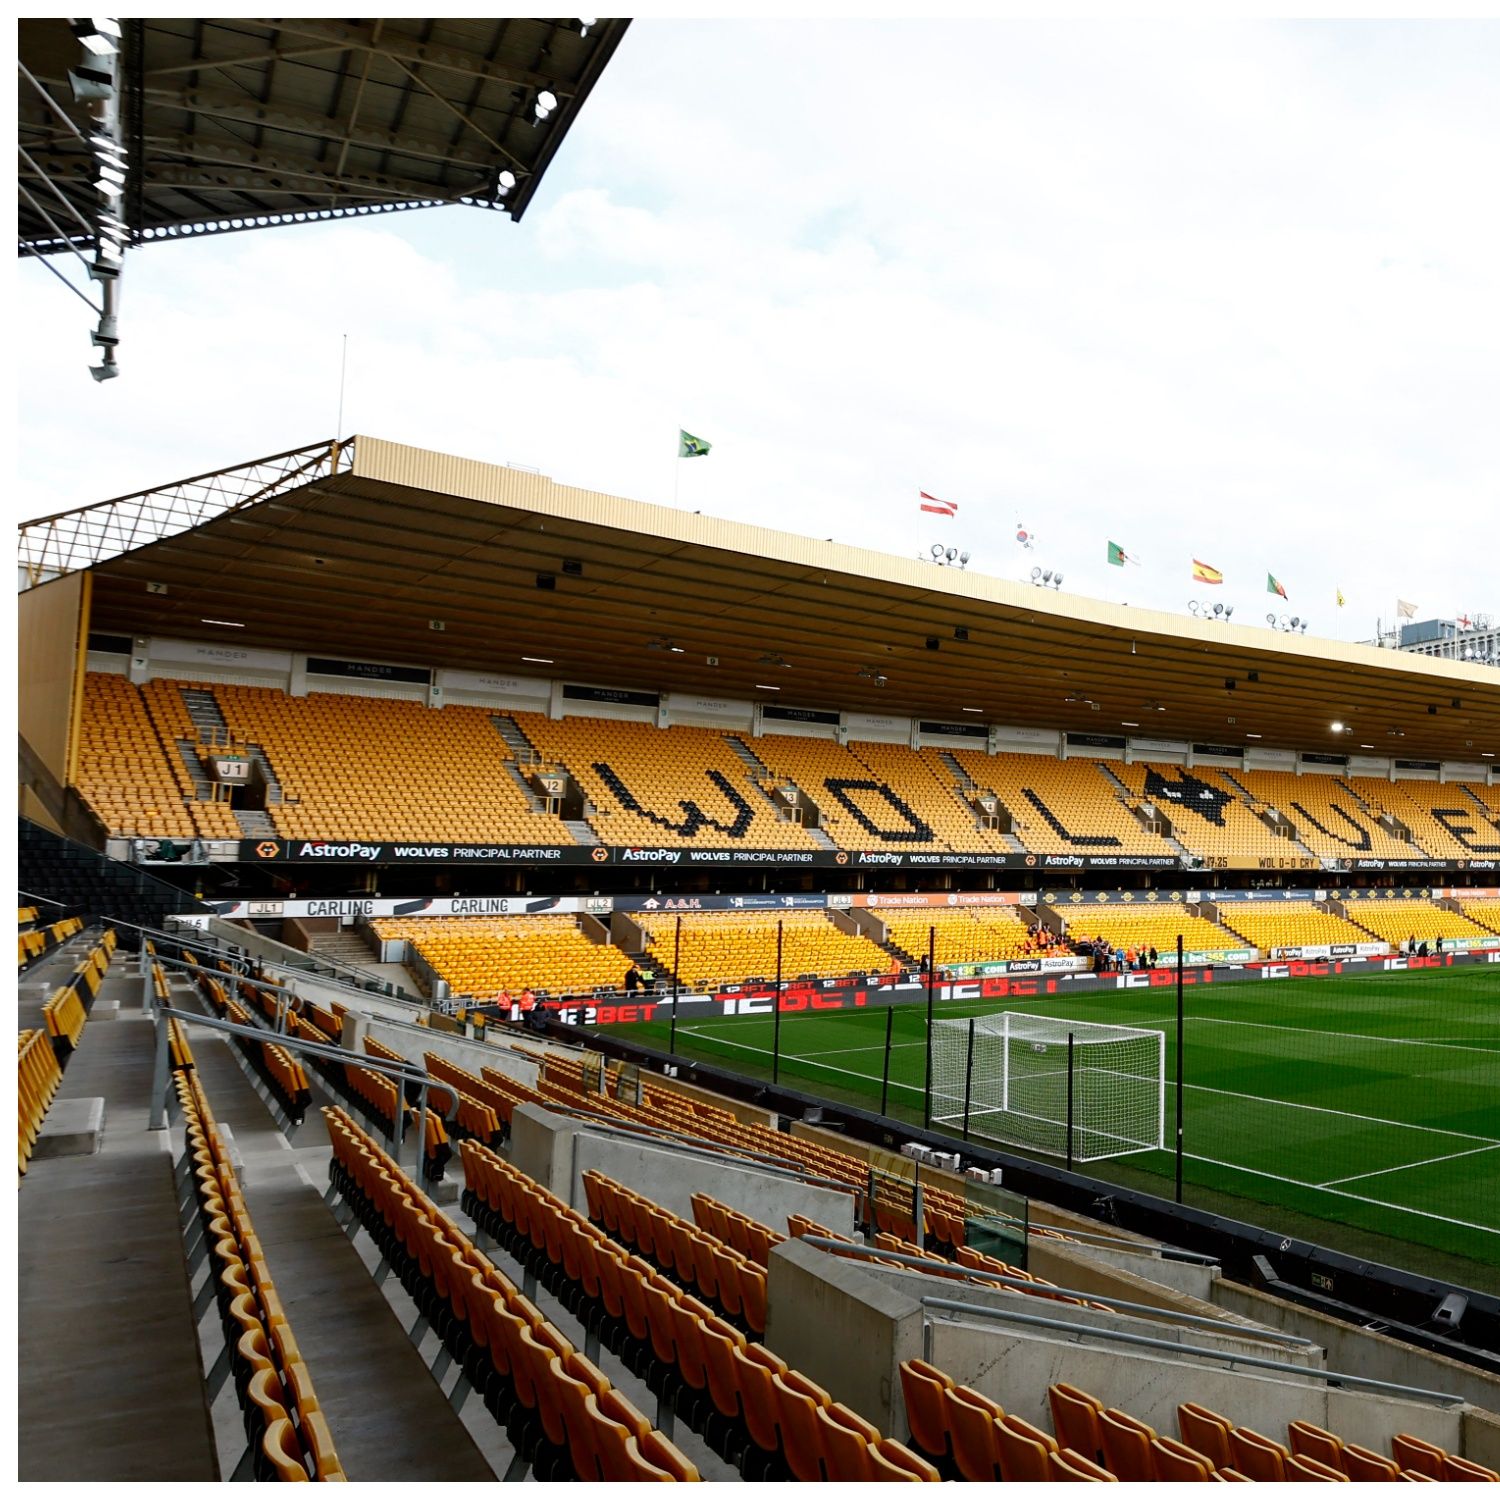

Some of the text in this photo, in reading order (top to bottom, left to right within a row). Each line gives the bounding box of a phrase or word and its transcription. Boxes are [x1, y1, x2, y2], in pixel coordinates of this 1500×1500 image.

[197, 649, 248, 660] MANDER
[347, 664, 393, 674] MANDER
[479, 678, 519, 687] MANDER
[594, 690, 629, 699] MANDER
[786, 710, 816, 718] MANDER
[300, 842, 561, 860] AstroPay WOLVES PRINCIPAL PARTNER
[623, 848, 813, 864] AstroPay WOLVES PRINCIPAL PARTNER
[858, 852, 1006, 865] AstroPay WOLVES PRINCIPAL PARTNER
[1045, 855, 1084, 867] AstroPay
[1090, 857, 1117, 865] WOLVES
[1258, 857, 1275, 868] WOL
[1300, 857, 1315, 868] CRY
[1357, 859, 1385, 870] AstroPay
[1470, 860, 1495, 869] AstroPay
[879, 895, 928, 905] Trade Nation
[959, 894, 1005, 903] Trade Nation
[257, 903, 277, 913] JL1
[307, 901, 374, 916] CARLING
[451, 899, 509, 913] CARLING
[1189, 949, 1249, 962] bet365.com
[1009, 961, 1040, 973] AstroPay
[1044, 958, 1074, 968] AstroPay
